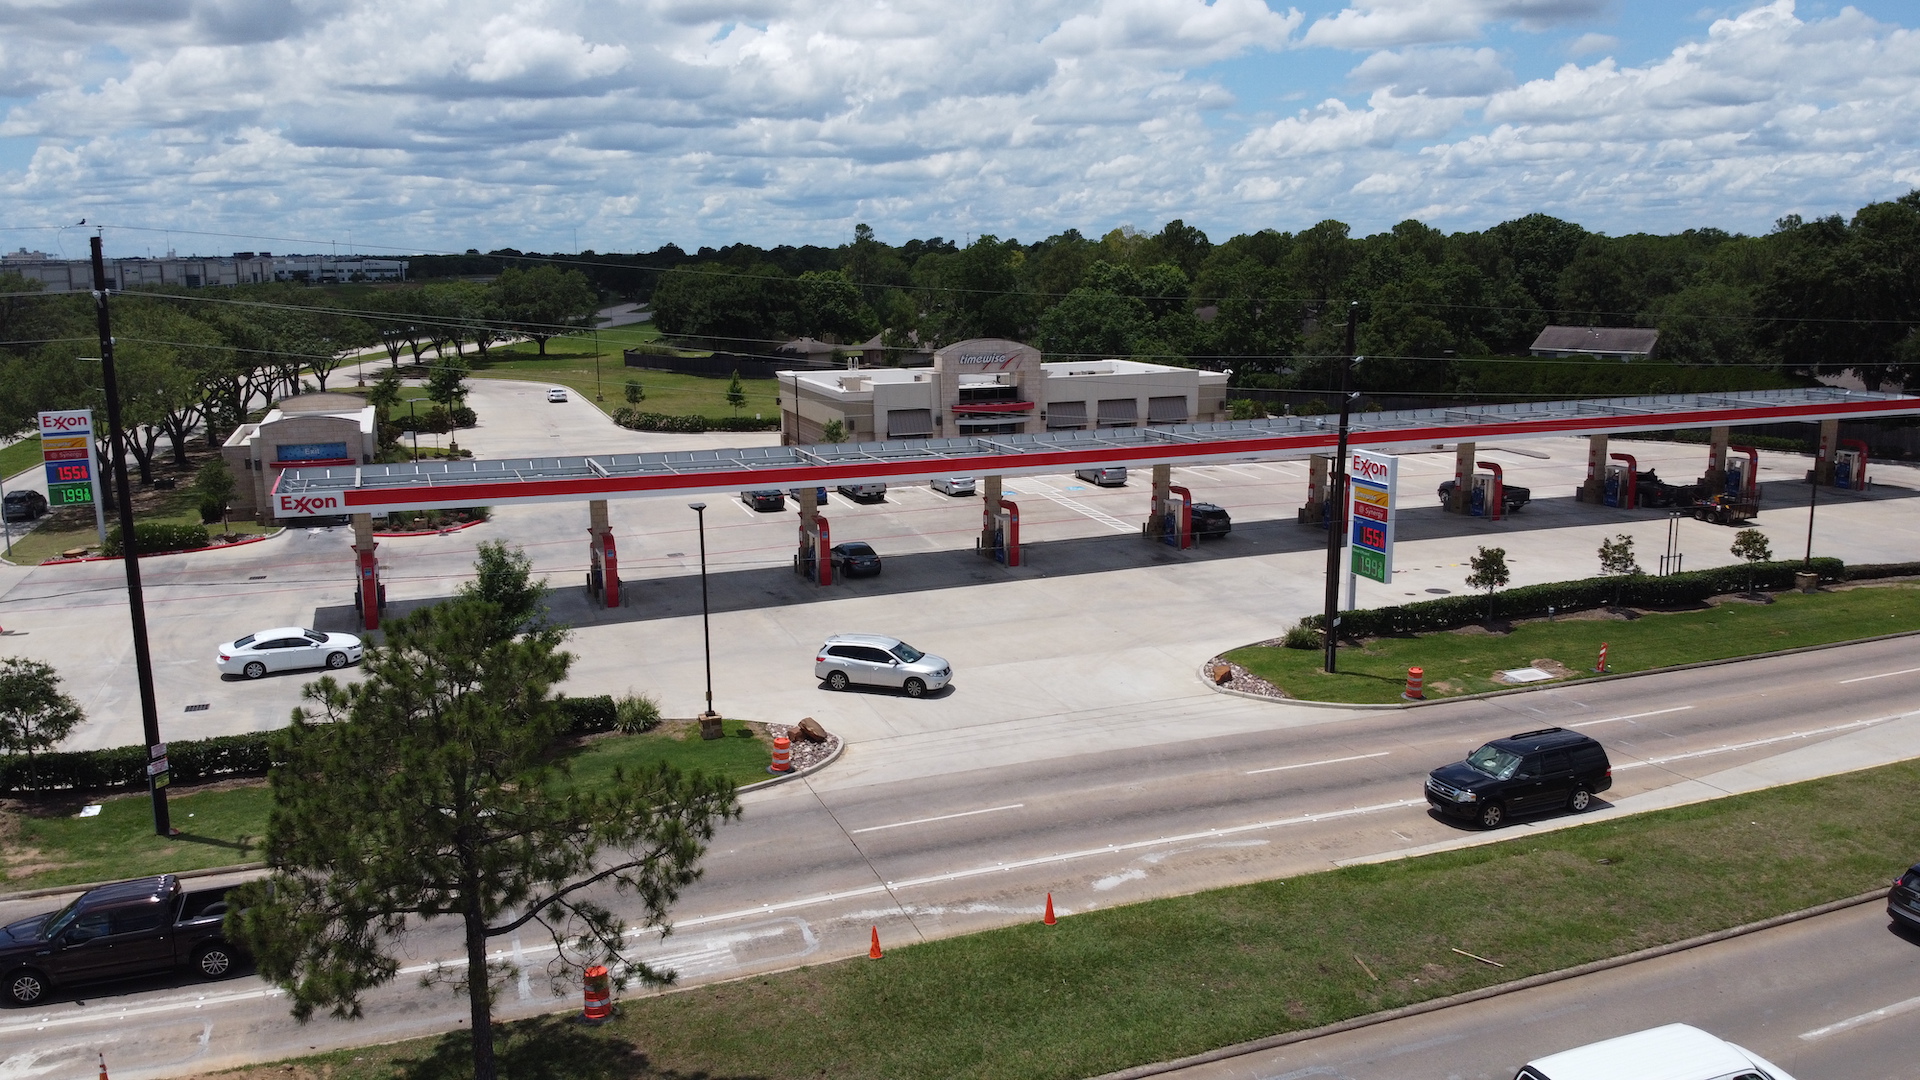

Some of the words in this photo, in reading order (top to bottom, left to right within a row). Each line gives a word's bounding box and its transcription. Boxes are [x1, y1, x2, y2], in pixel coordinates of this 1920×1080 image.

[959, 353, 1006, 364] timewise
[42, 416, 87, 430] Exxon
[1353, 455, 1387, 480] Exxon
[280, 496, 337, 514] Exxon
